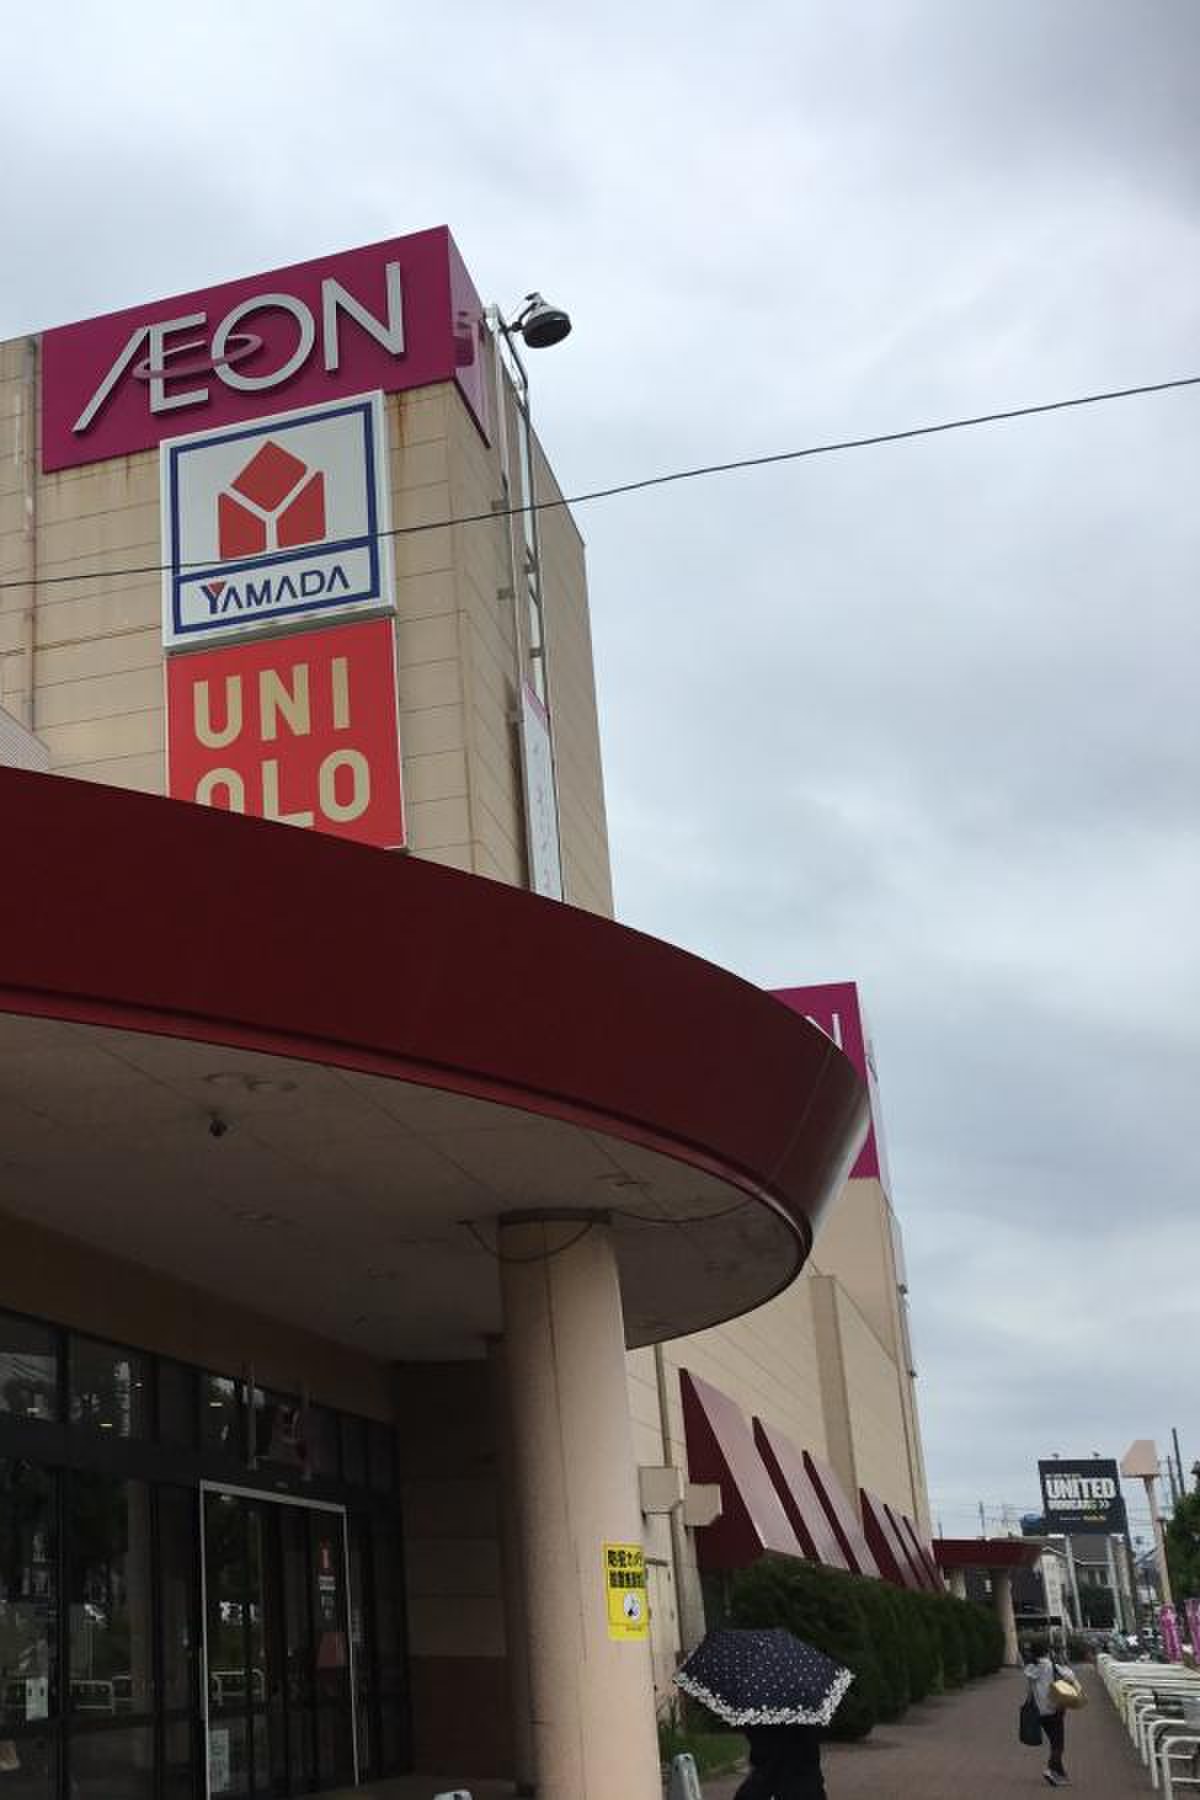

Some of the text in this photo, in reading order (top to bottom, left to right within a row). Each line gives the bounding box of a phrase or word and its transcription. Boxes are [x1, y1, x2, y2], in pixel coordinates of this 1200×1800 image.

[201, 565, 350, 614] YAMADA
[193, 657, 349, 749] UNI
[1045, 1478, 1117, 1499] UNITED
